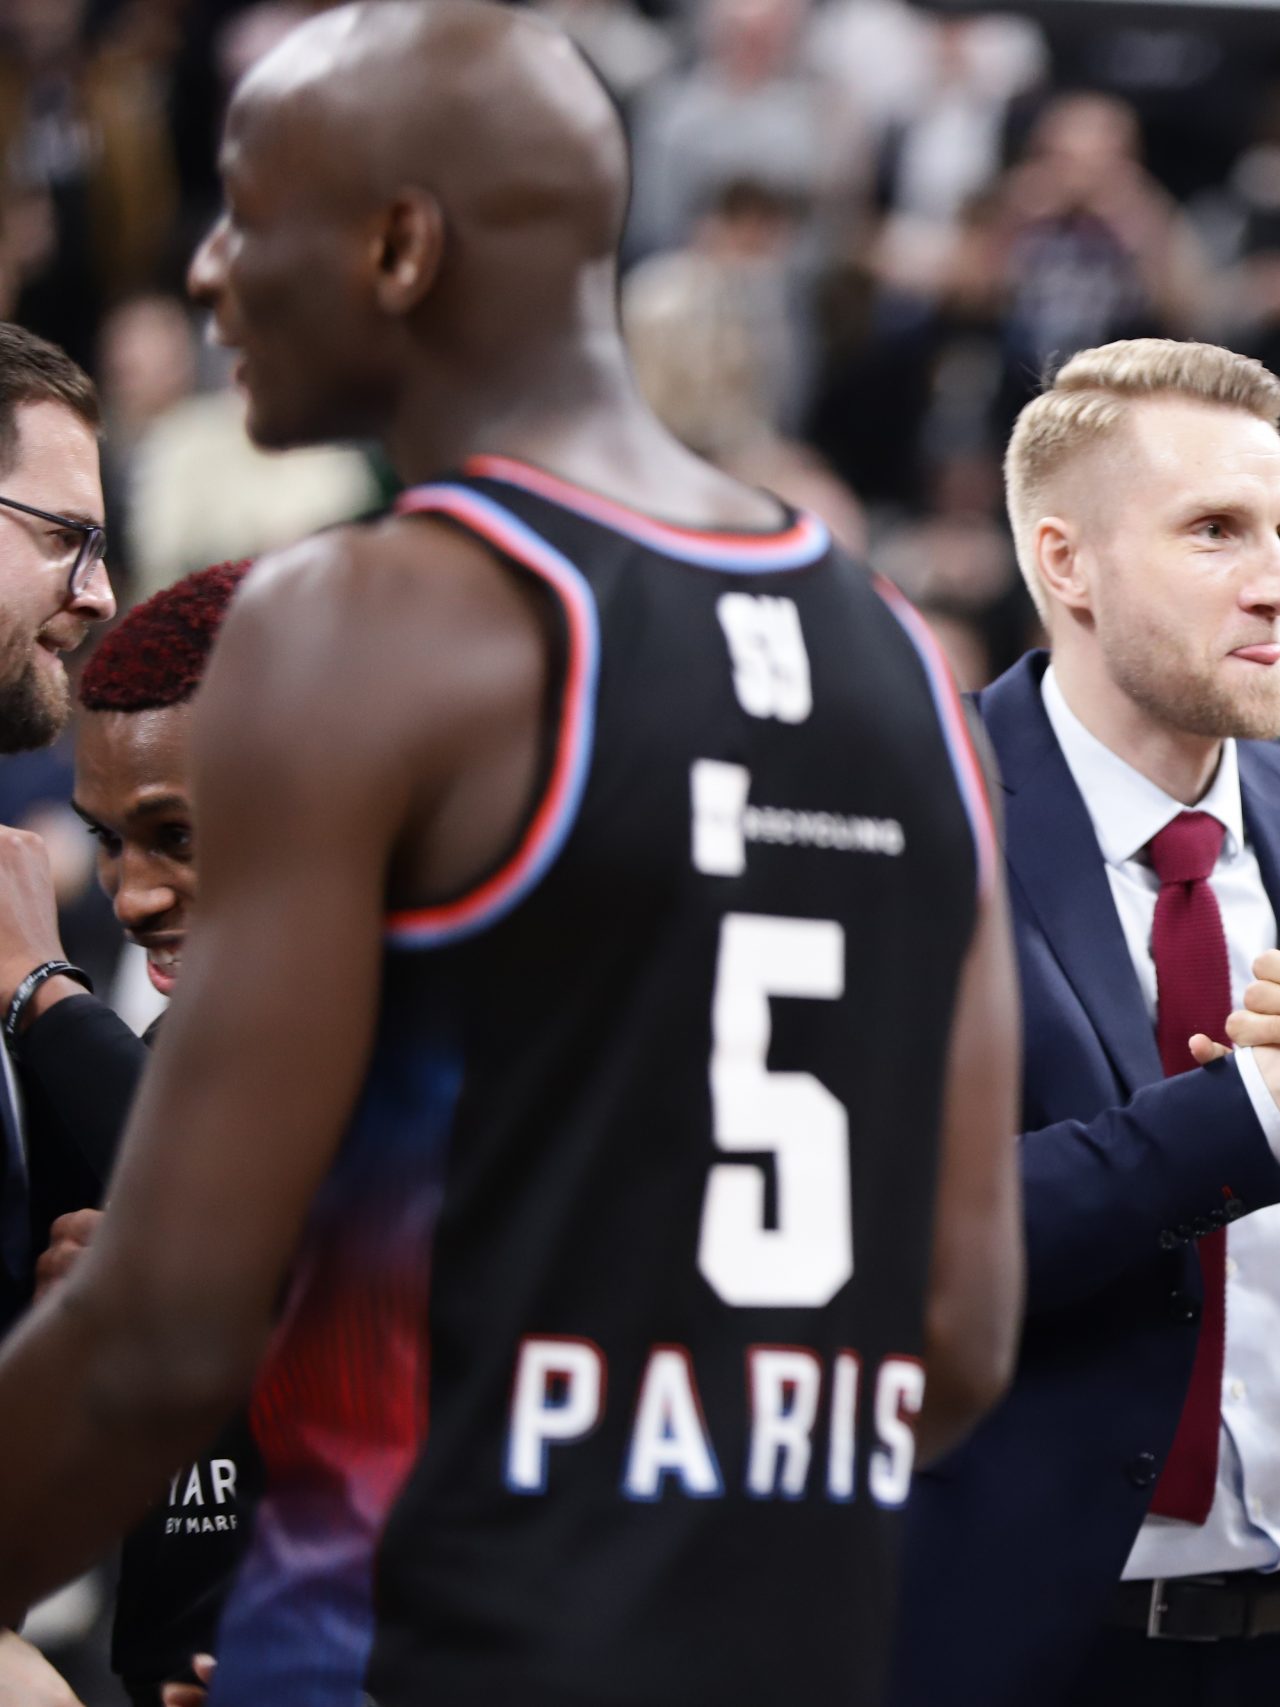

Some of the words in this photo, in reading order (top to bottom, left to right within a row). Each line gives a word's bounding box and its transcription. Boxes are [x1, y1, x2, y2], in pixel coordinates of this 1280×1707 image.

[697, 911, 855, 1309] 5
[505, 1332, 926, 1510] PARIS
[165, 1517, 183, 1535] BY
